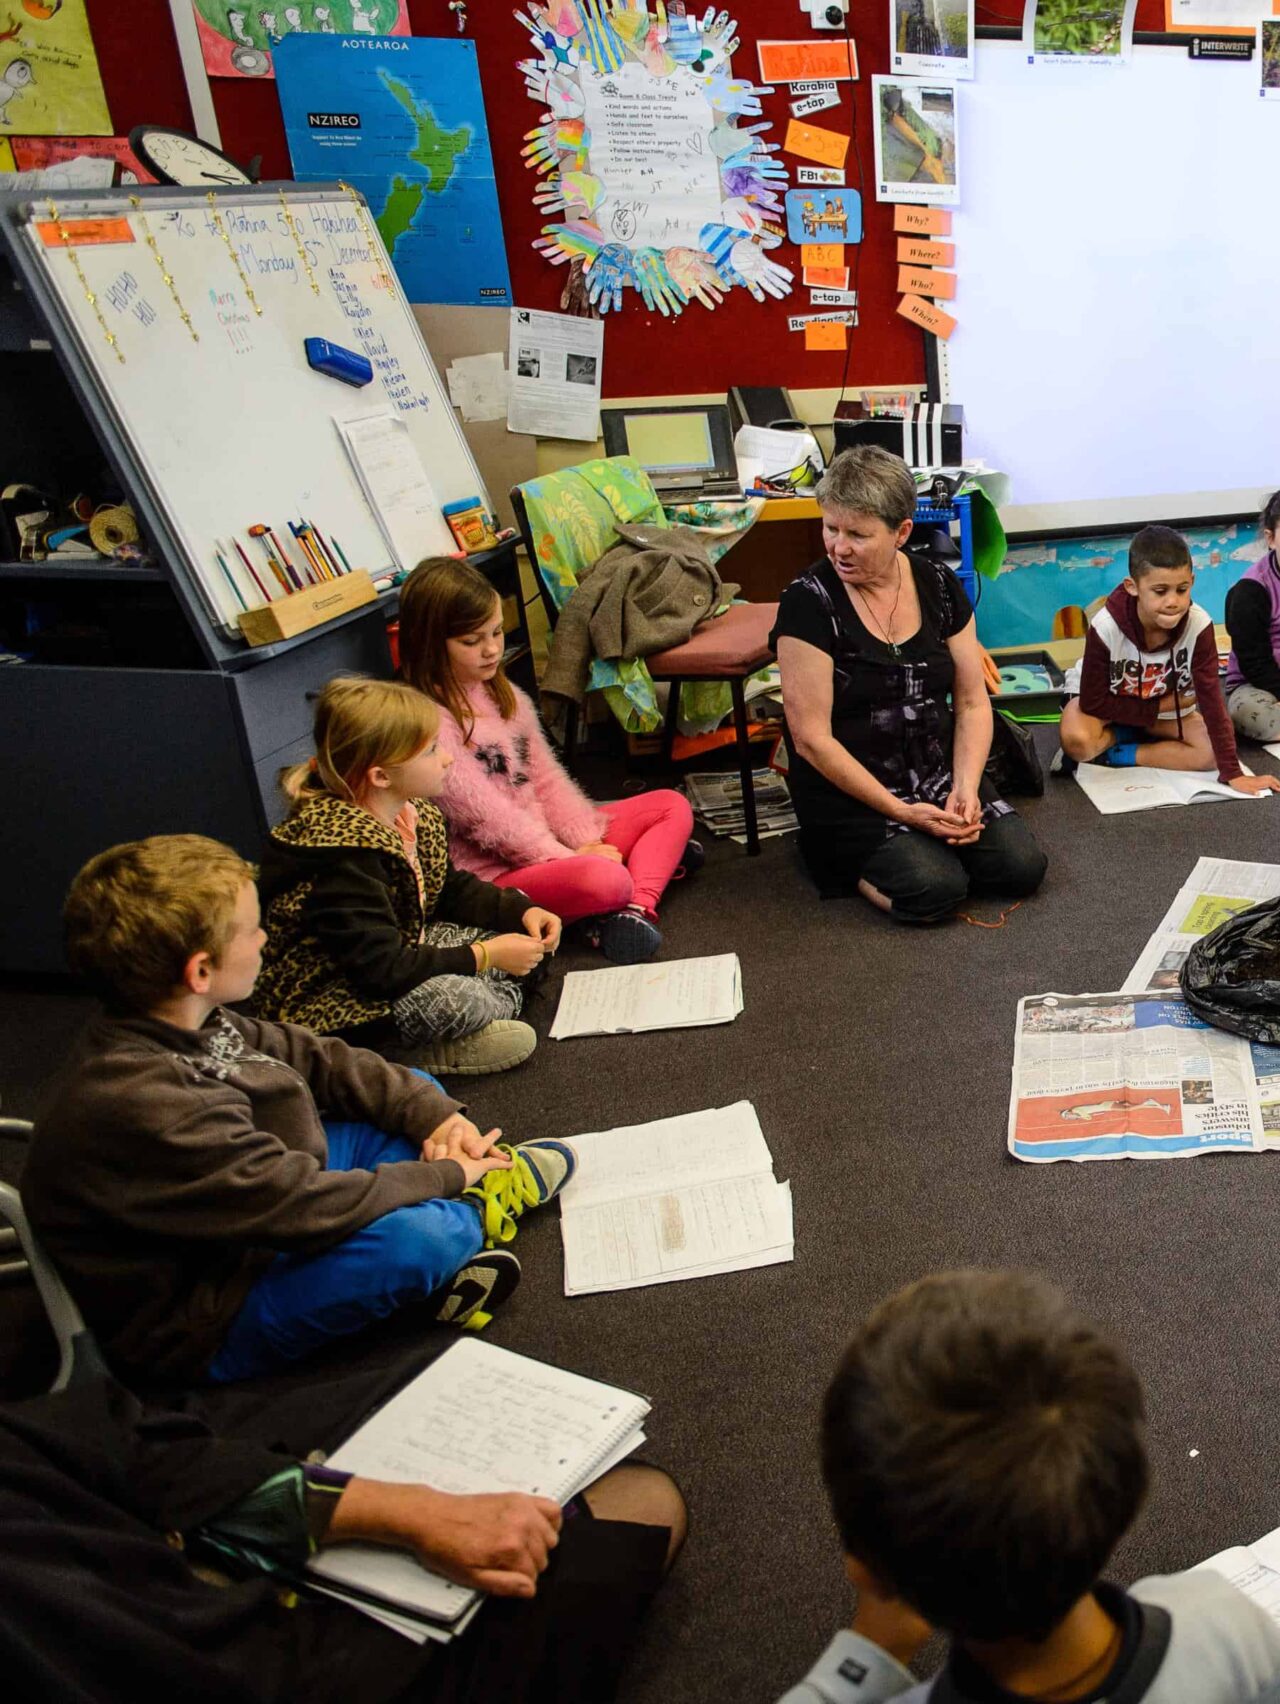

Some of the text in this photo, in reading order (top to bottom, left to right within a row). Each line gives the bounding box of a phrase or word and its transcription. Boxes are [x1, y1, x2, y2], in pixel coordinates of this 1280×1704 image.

[342, 39, 409, 51] AOTEAROA
[1201, 41, 1249, 51] INTERWRITE
[791, 82, 835, 92] Karakia
[658, 94, 677, 102] Treaty
[796, 96, 825, 112] e-tap
[309, 115, 359, 127] NZIREO
[800, 171, 818, 181] FB1
[906, 214, 930, 227] Why?
[909, 248, 941, 260] Where?
[910, 279, 935, 291] Who?
[812, 292, 841, 303] e-tap
[911, 305, 939, 326] When?
[1207, 1103, 1235, 1112] style
[1194, 1111, 1230, 1119] critics
[1201, 1117, 1250, 1125] answers
[1202, 1123, 1251, 1131] Johnson
[1200, 1132, 1252, 1143] Sport
